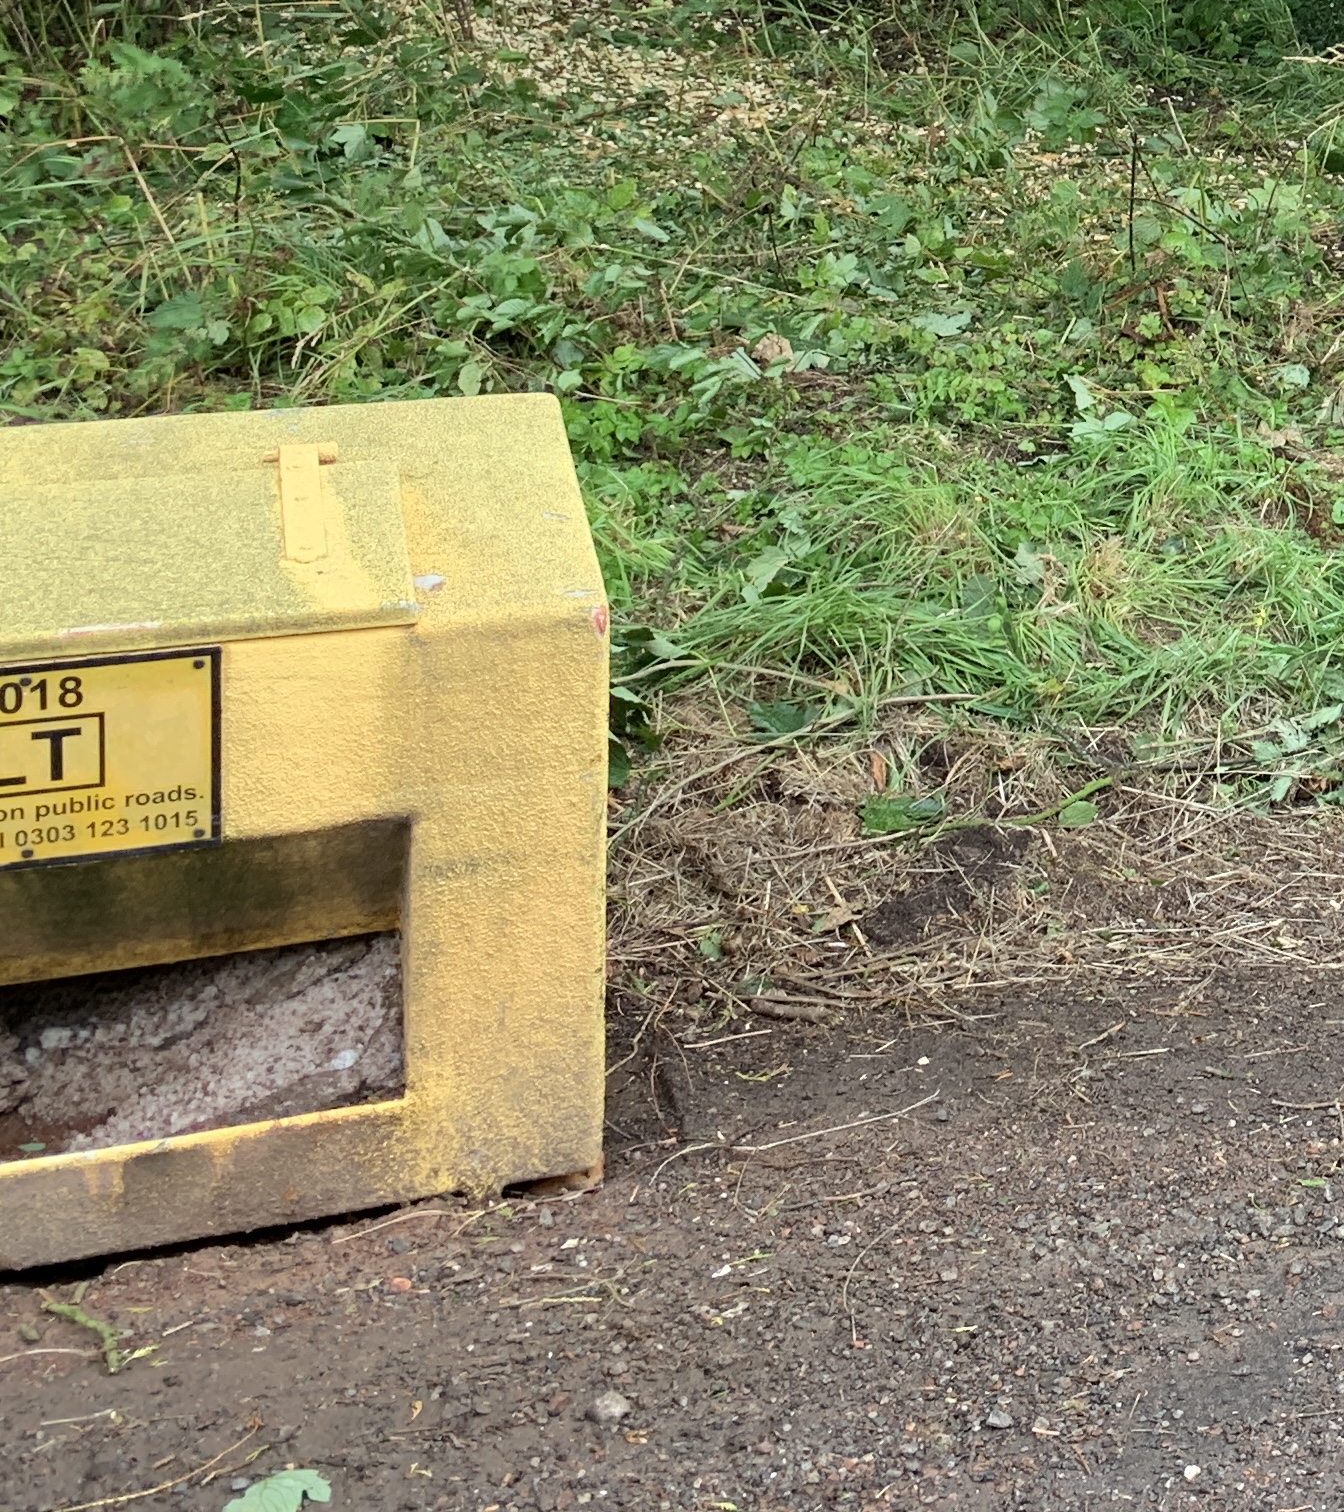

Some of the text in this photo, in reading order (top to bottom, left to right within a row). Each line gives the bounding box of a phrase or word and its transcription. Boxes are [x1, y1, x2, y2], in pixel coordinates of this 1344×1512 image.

[0, 676, 84, 714] 018
[35, 793, 116, 822] public
[125, 785, 204, 808] roads.
[15, 825, 76, 847] 0303
[86, 818, 130, 838] 123
[140, 810, 199, 832] 1015
